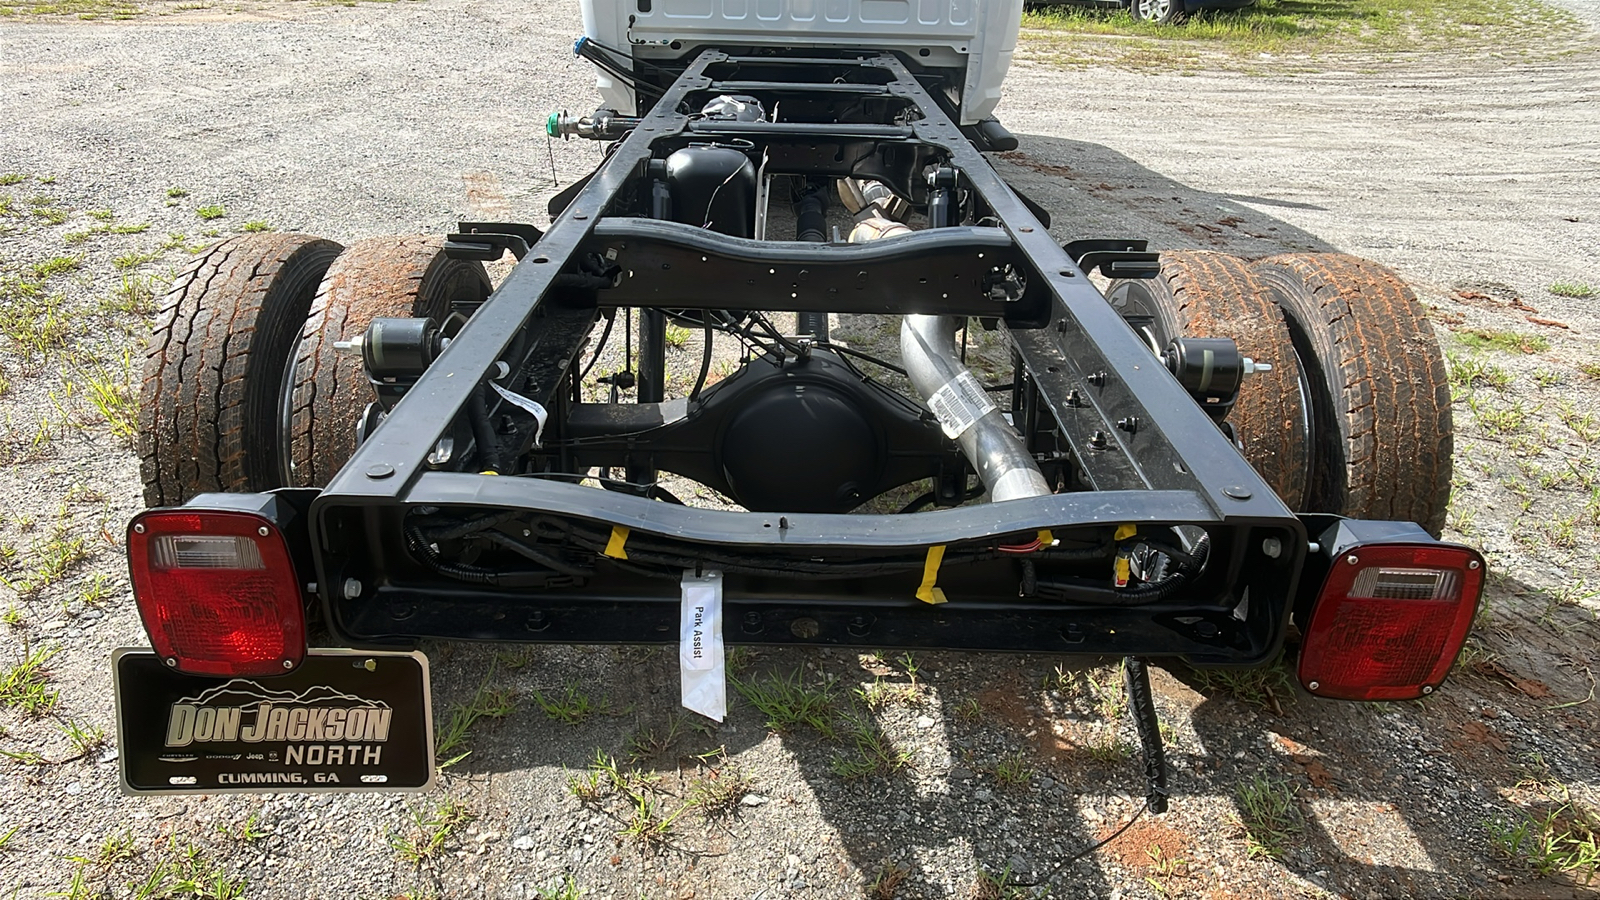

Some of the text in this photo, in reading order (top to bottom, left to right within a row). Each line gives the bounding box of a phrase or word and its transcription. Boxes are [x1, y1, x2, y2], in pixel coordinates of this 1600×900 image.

[693, 606, 704, 659] Park Assist
[165, 702, 393, 747] DON JACKSON
[246, 752, 264, 760] Jeep
[284, 745, 382, 765] NORTH
[217, 772, 340, 785] CUMMING, GA
